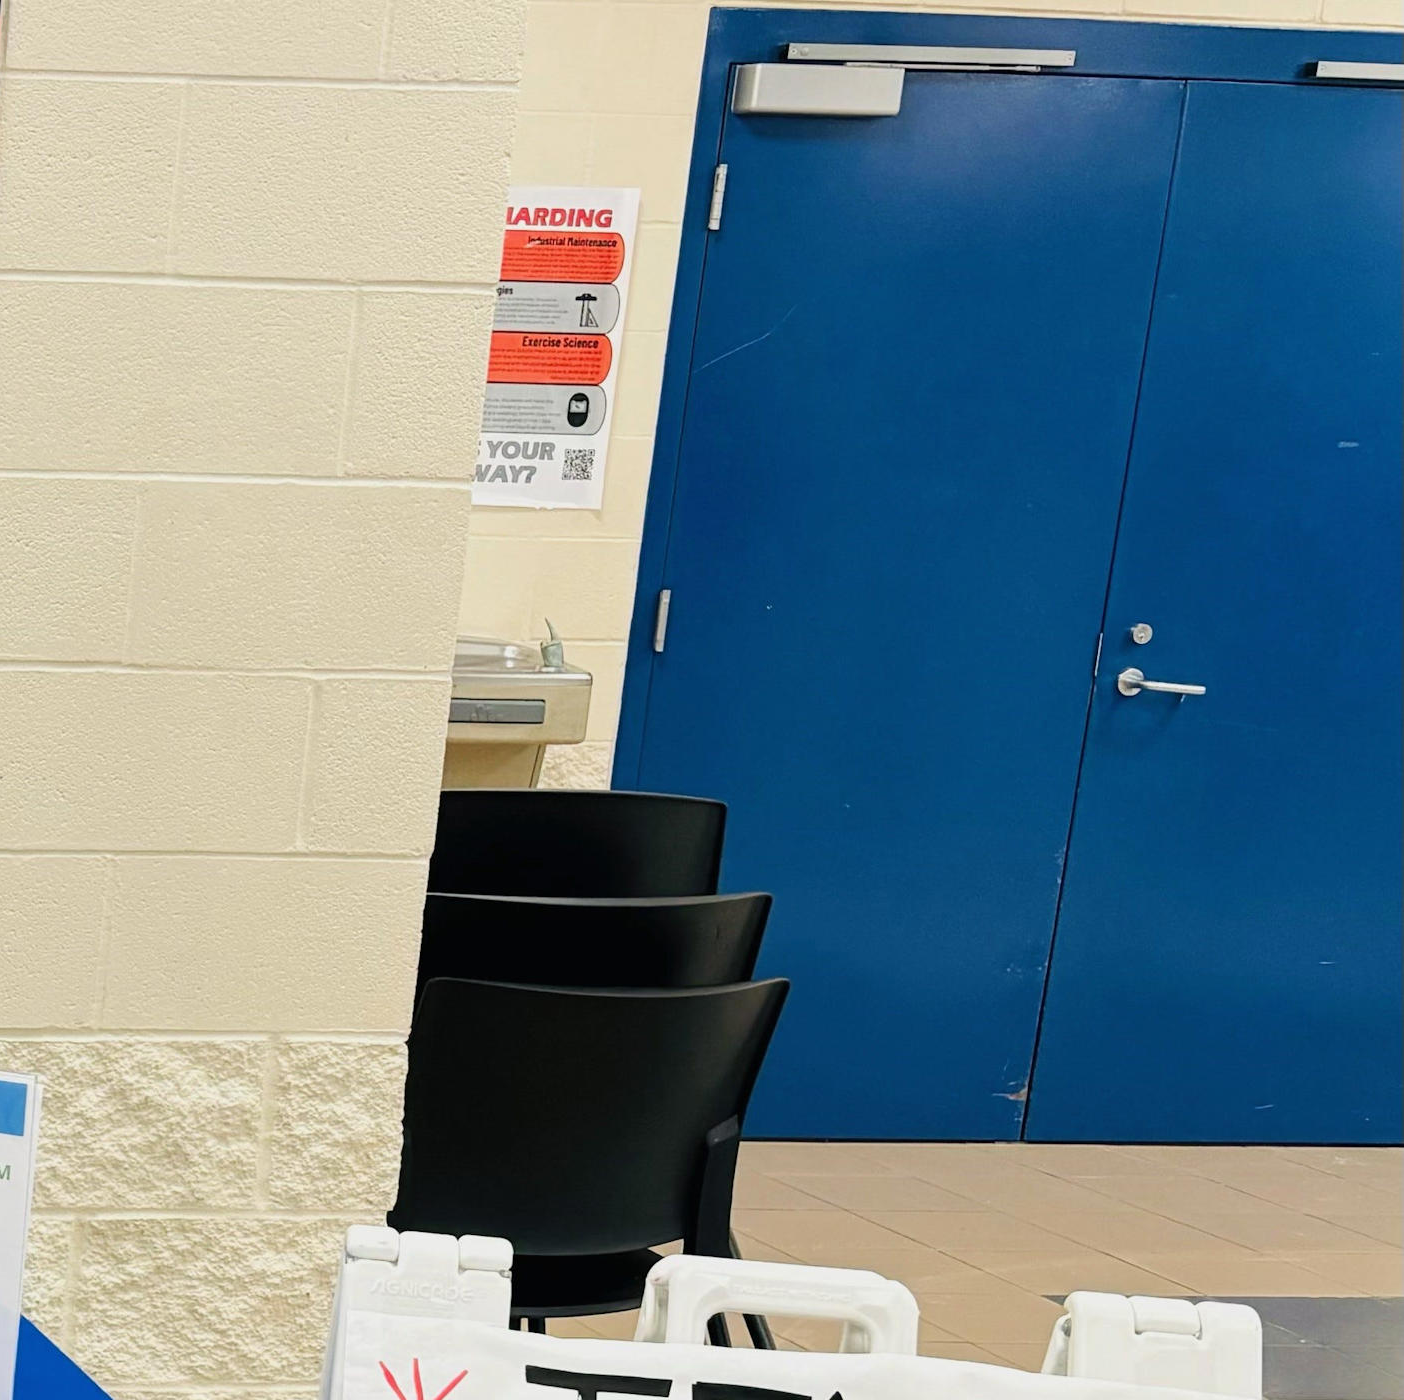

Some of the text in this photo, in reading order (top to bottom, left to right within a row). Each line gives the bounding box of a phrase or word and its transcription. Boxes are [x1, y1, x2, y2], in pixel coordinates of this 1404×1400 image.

[567, 237, 618, 248] Maintenance
[522, 336, 599, 349] Exercise Science
[487, 441, 556, 460] YOUR
